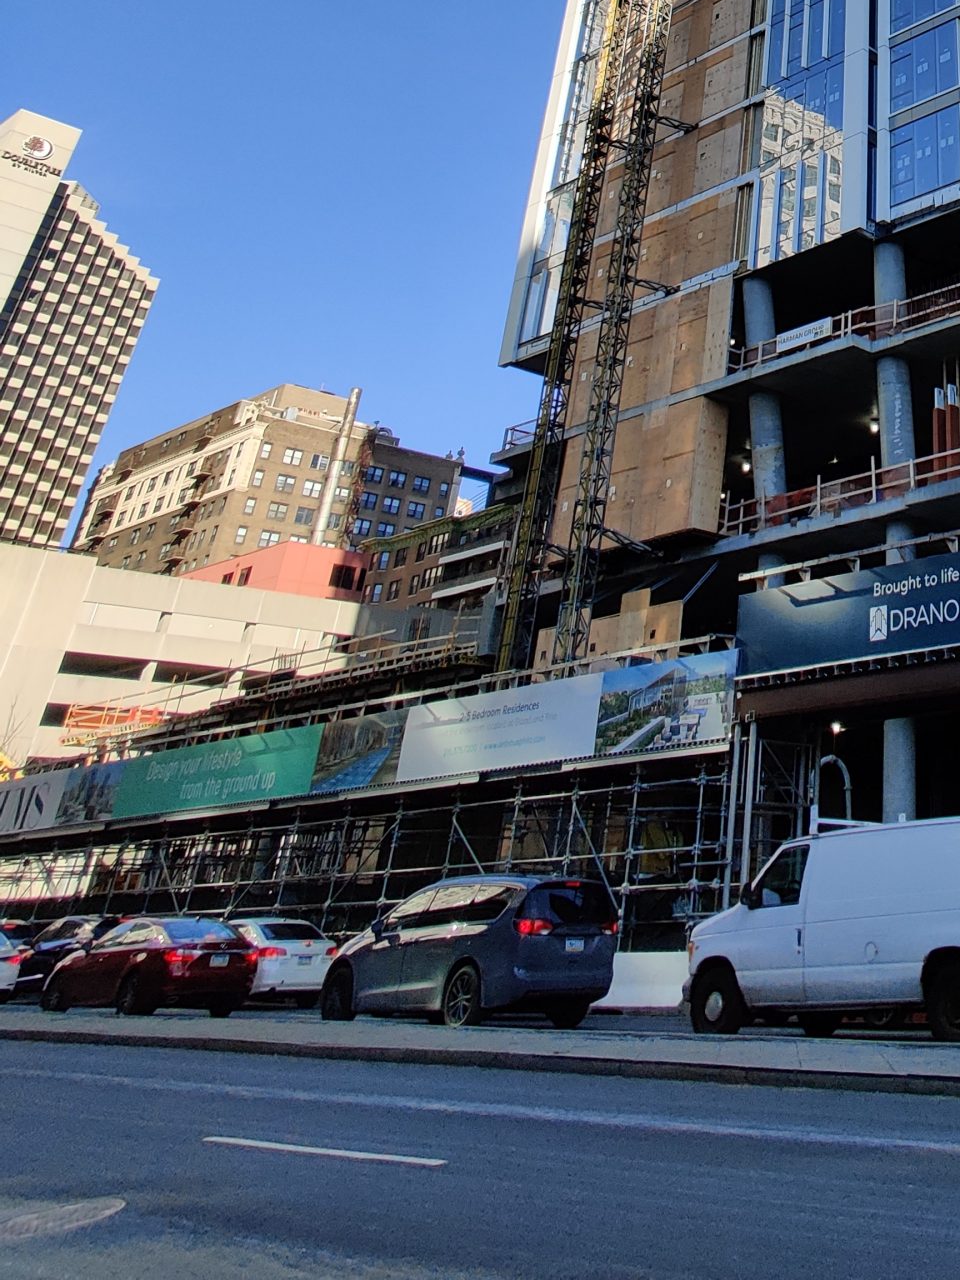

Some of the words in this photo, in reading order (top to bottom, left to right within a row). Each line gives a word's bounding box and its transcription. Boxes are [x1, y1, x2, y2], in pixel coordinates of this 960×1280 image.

[873, 576, 921, 597] Brought
[924, 574, 938, 587] to
[941, 567, 960, 584] life
[472, 707, 501, 720] Bedroom
[502, 701, 540, 715] Residences
[146, 761, 178, 782] Design
[178, 756, 201, 778] your
[203, 749, 242, 771] lifestyle
[179, 779, 203, 799] from
[204, 776, 221, 796] the
[223, 770, 261, 798] ground
[260, 771, 276, 792] up
